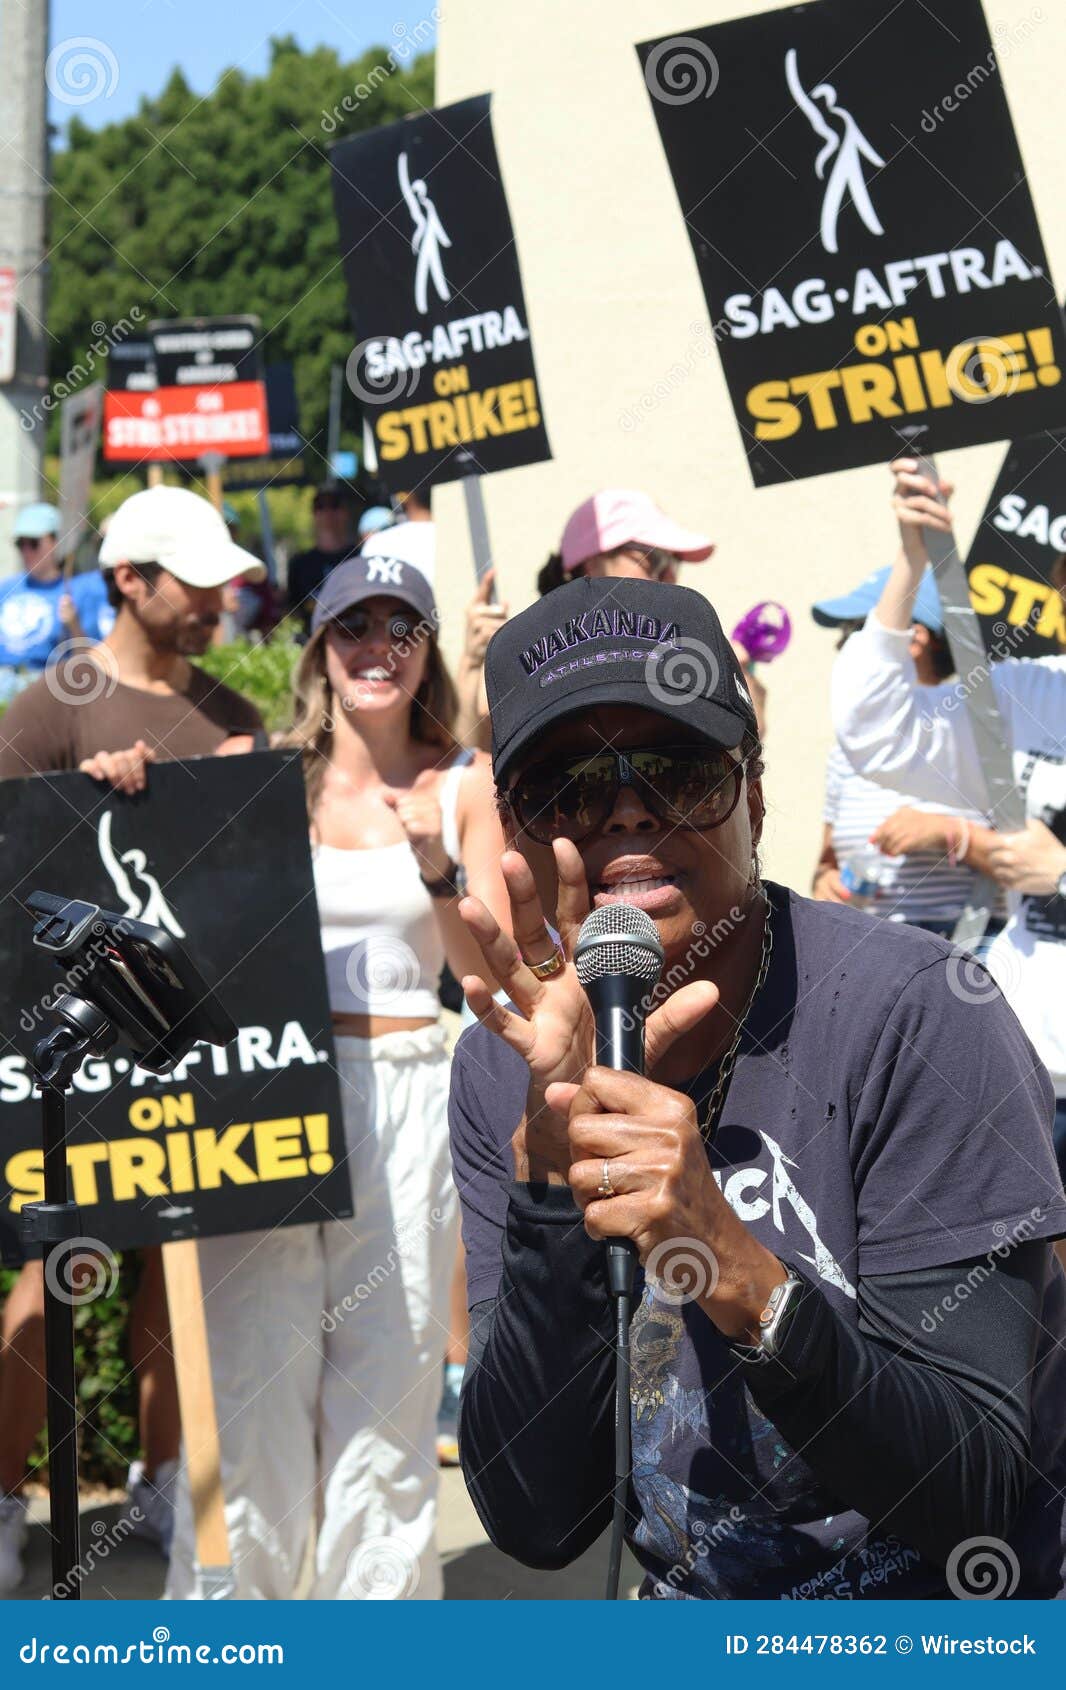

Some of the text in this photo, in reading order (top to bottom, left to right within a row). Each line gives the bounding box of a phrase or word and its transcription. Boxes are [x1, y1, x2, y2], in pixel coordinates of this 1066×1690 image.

[854, 316, 920, 357] ON
[433, 364, 470, 396] ON
[746, 326, 1062, 441] STRIKE!
[375, 377, 540, 461] STRIKE!
[519, 608, 683, 677] WAKANDA
[546, 650, 660, 682] ATHLETICS
[128, 1092, 196, 1131] ON
[5, 1112, 335, 1214] STRIKE!
